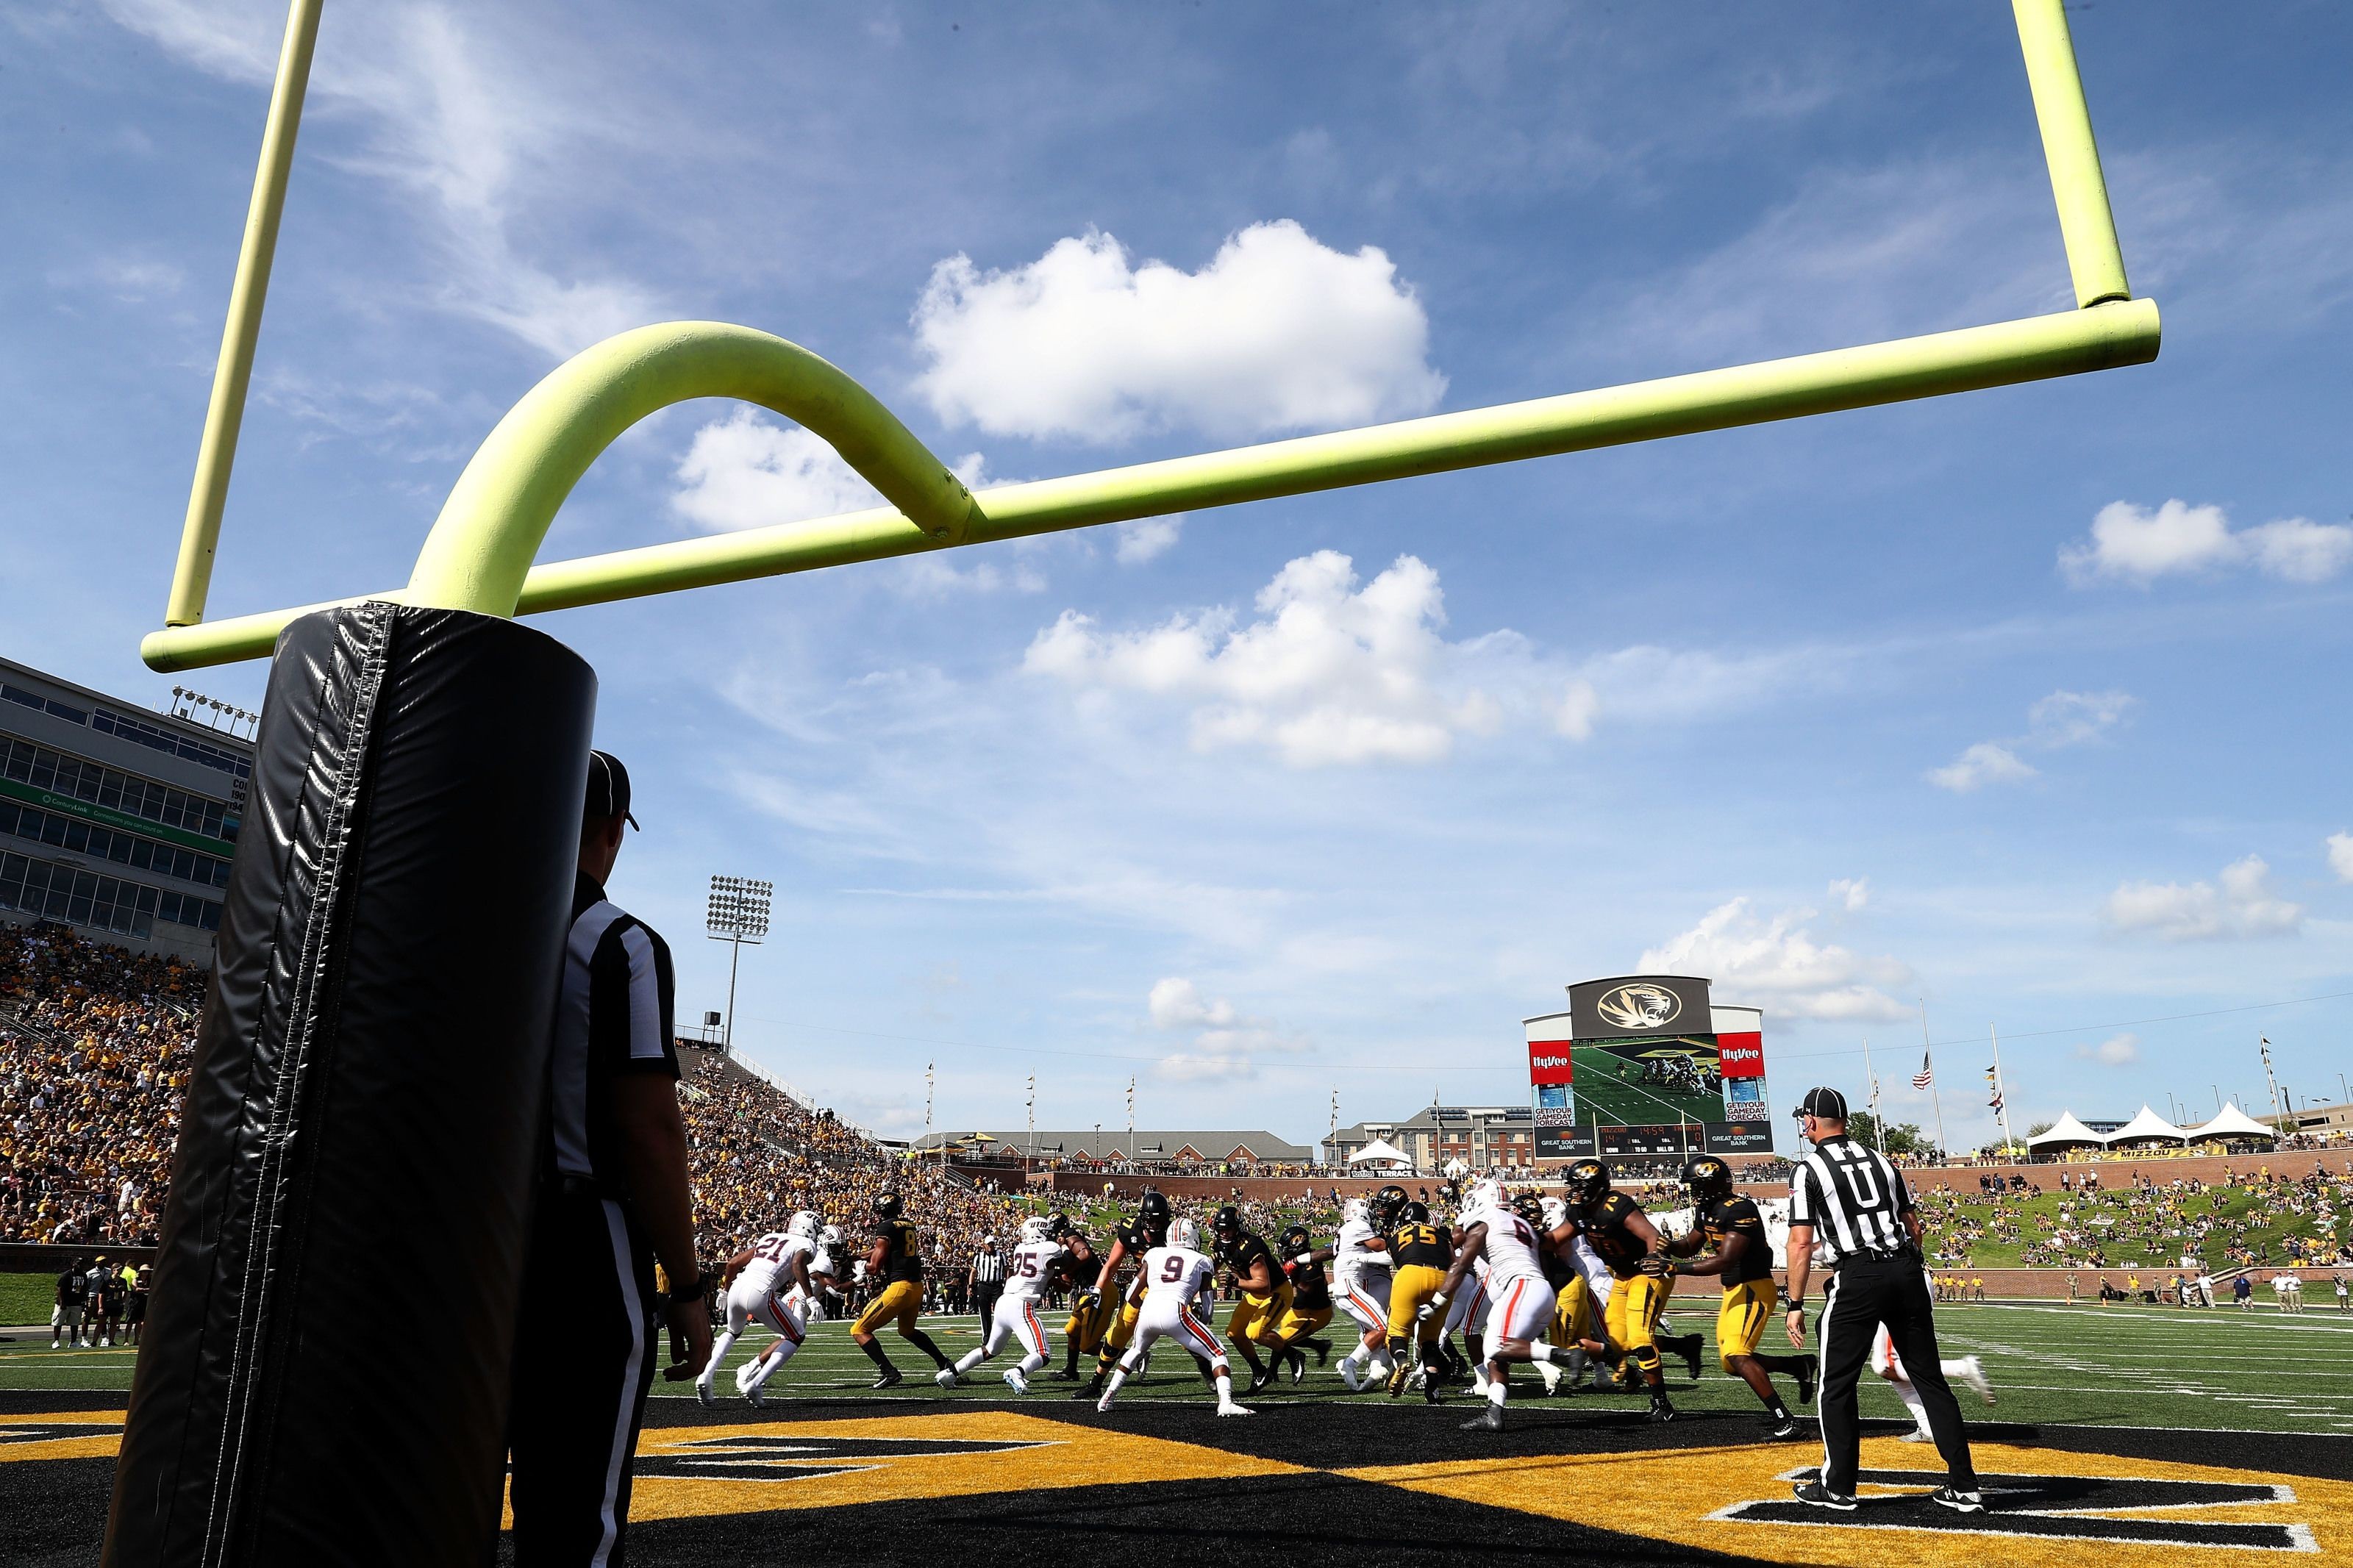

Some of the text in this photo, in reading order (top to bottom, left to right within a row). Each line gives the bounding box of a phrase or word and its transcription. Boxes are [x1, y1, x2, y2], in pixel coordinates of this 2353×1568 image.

[52, 798, 88, 813] CenturyLink
[1606, 1135, 1615, 1143] 14
[1640, 1126, 1665, 1135] 14:59
[2121, 1149, 2170, 1158] MIZZOU
[1840, 1161, 1881, 1208] U
[1398, 1224, 1437, 1253] 55
[754, 1236, 790, 1264] 21
[1160, 1255, 1185, 1284] 9
